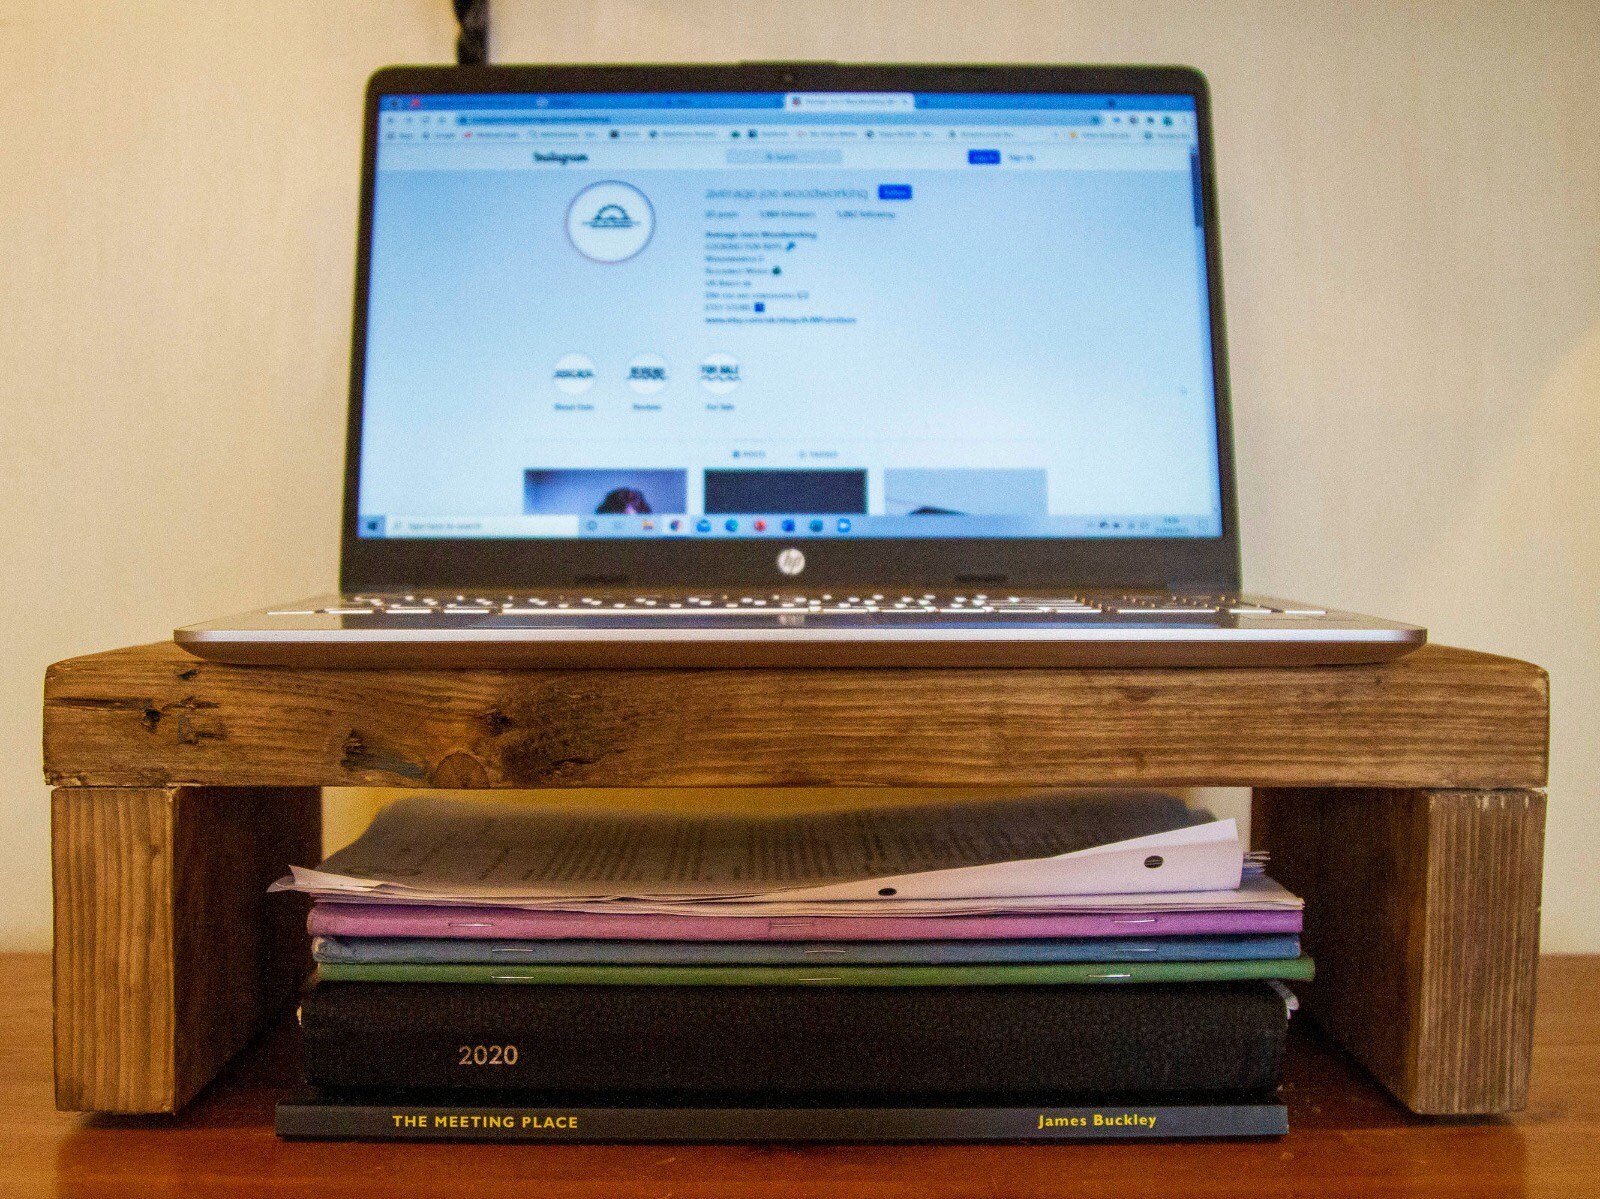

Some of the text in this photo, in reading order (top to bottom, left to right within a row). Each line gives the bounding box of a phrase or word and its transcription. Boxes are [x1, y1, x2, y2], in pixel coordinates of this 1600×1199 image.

[458, 1044, 519, 1066] 2020
[392, 1115, 579, 1129] THE MEETING PLACE
[1038, 1113, 1157, 1130] James Buckley
